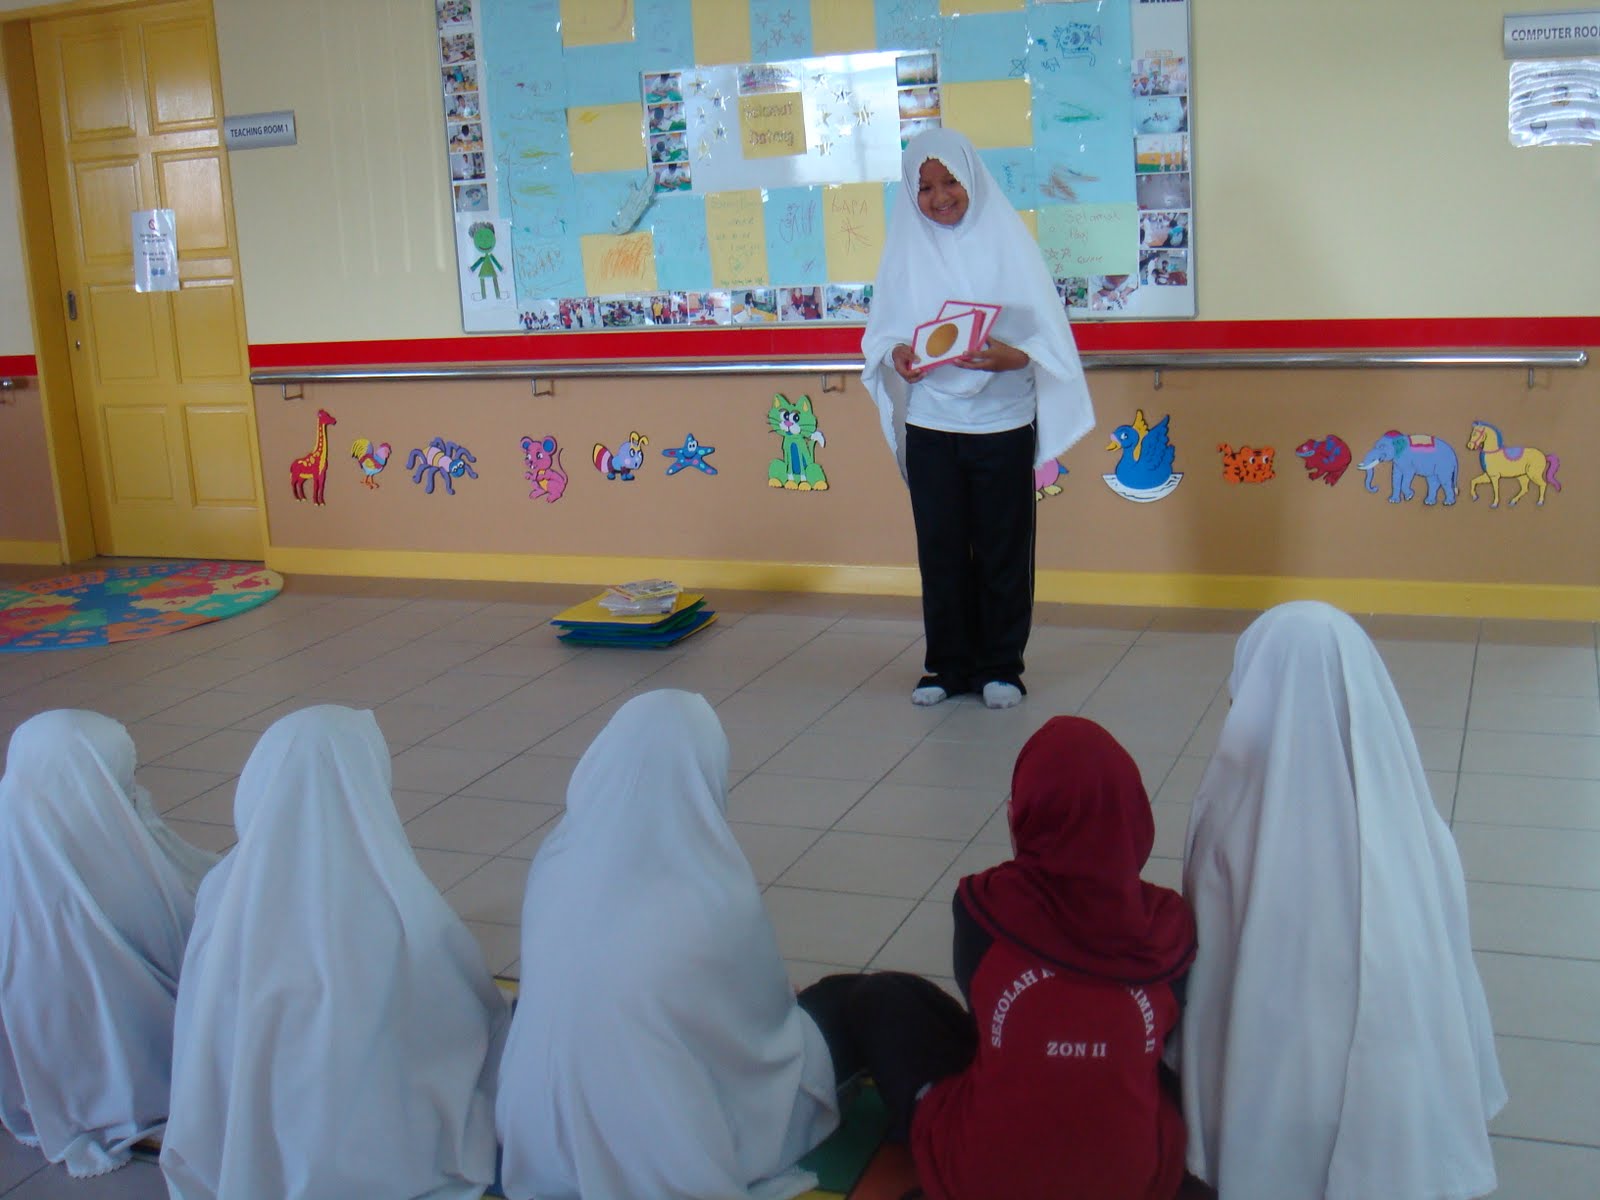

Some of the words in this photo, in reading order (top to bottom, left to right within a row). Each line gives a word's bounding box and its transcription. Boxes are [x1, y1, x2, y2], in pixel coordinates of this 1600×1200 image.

[1511, 27, 1572, 41] COMPUTER
[1574, 25, 1600, 38] ROO
[230, 127, 263, 137] TEACHING
[264, 125, 284, 134] ROOM
[285, 124, 289, 132] 1
[991, 969, 1038, 1049] SEKOLAH
[1046, 1042, 1087, 1057] ZON
[1092, 1043, 1107, 1057] II
